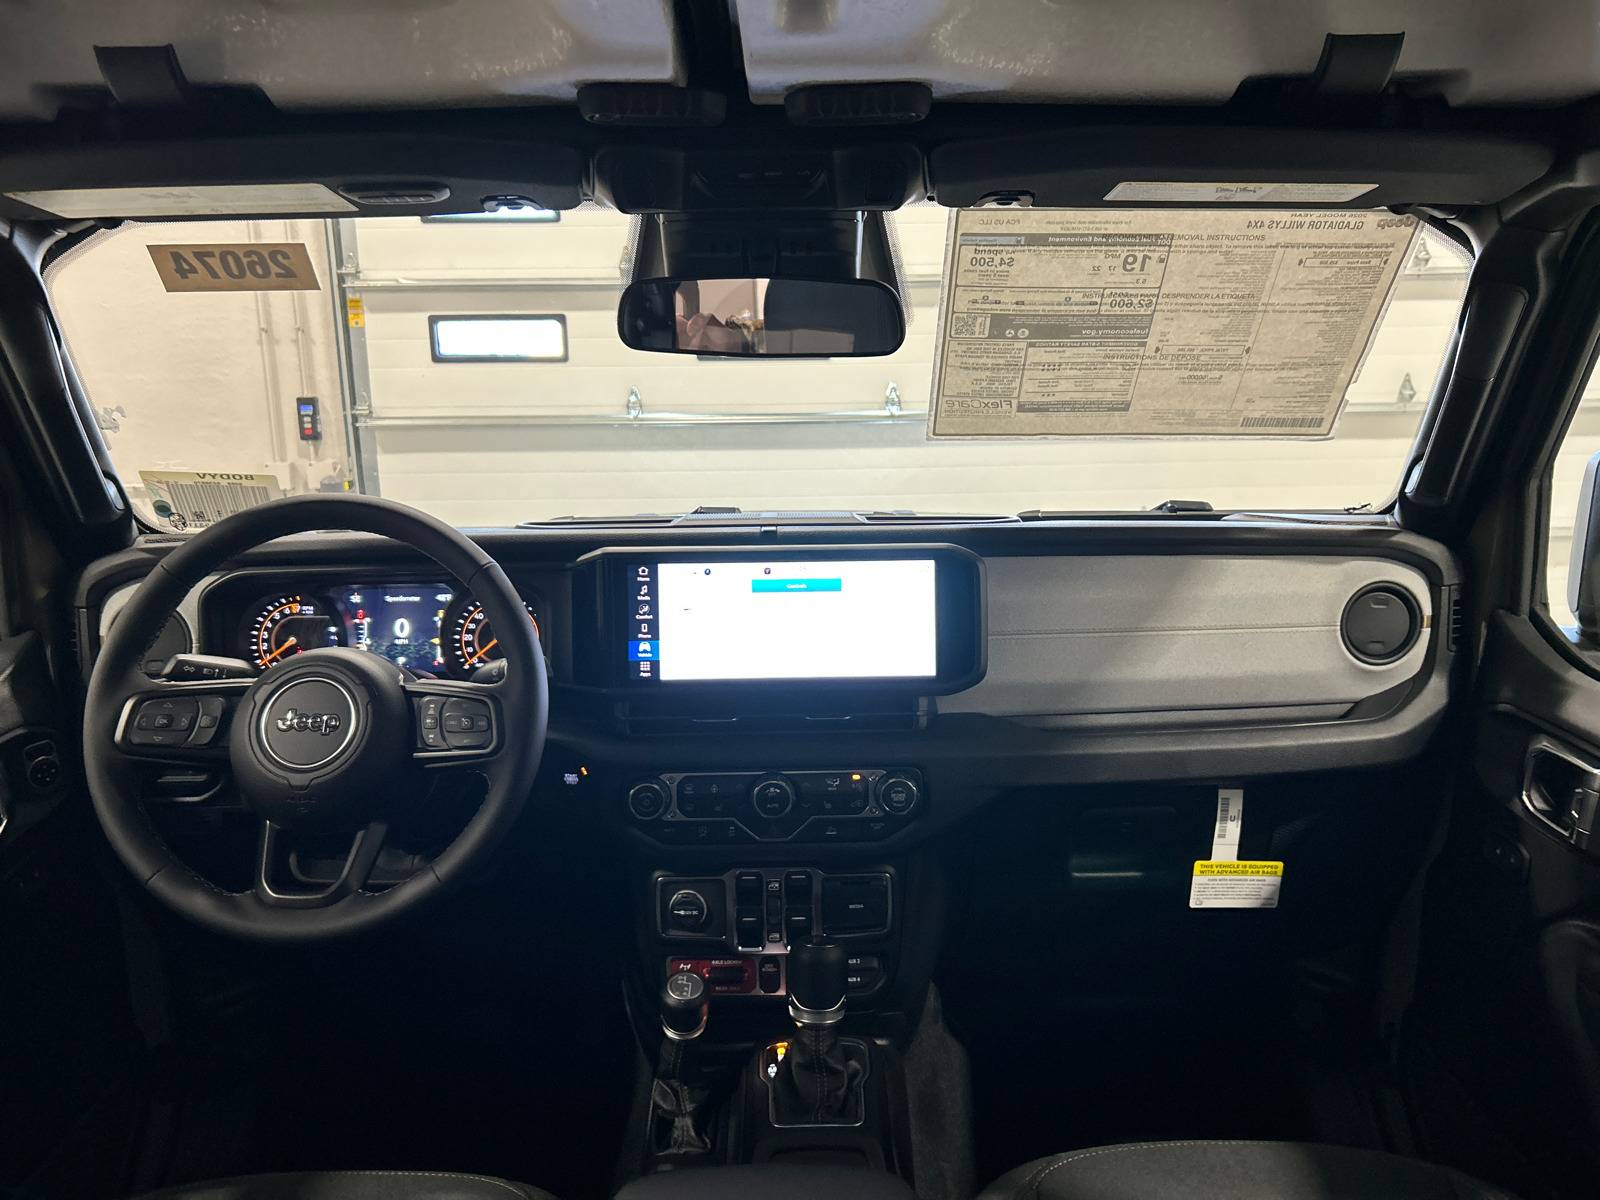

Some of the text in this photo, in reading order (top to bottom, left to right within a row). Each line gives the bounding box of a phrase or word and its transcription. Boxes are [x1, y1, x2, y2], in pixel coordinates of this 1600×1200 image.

[273, 612, 280, 620] 5
[394, 618, 410, 638] 0
[262, 631, 268, 639] 3
[262, 642, 268, 650] 2
[277, 708, 340, 736] Jeep
